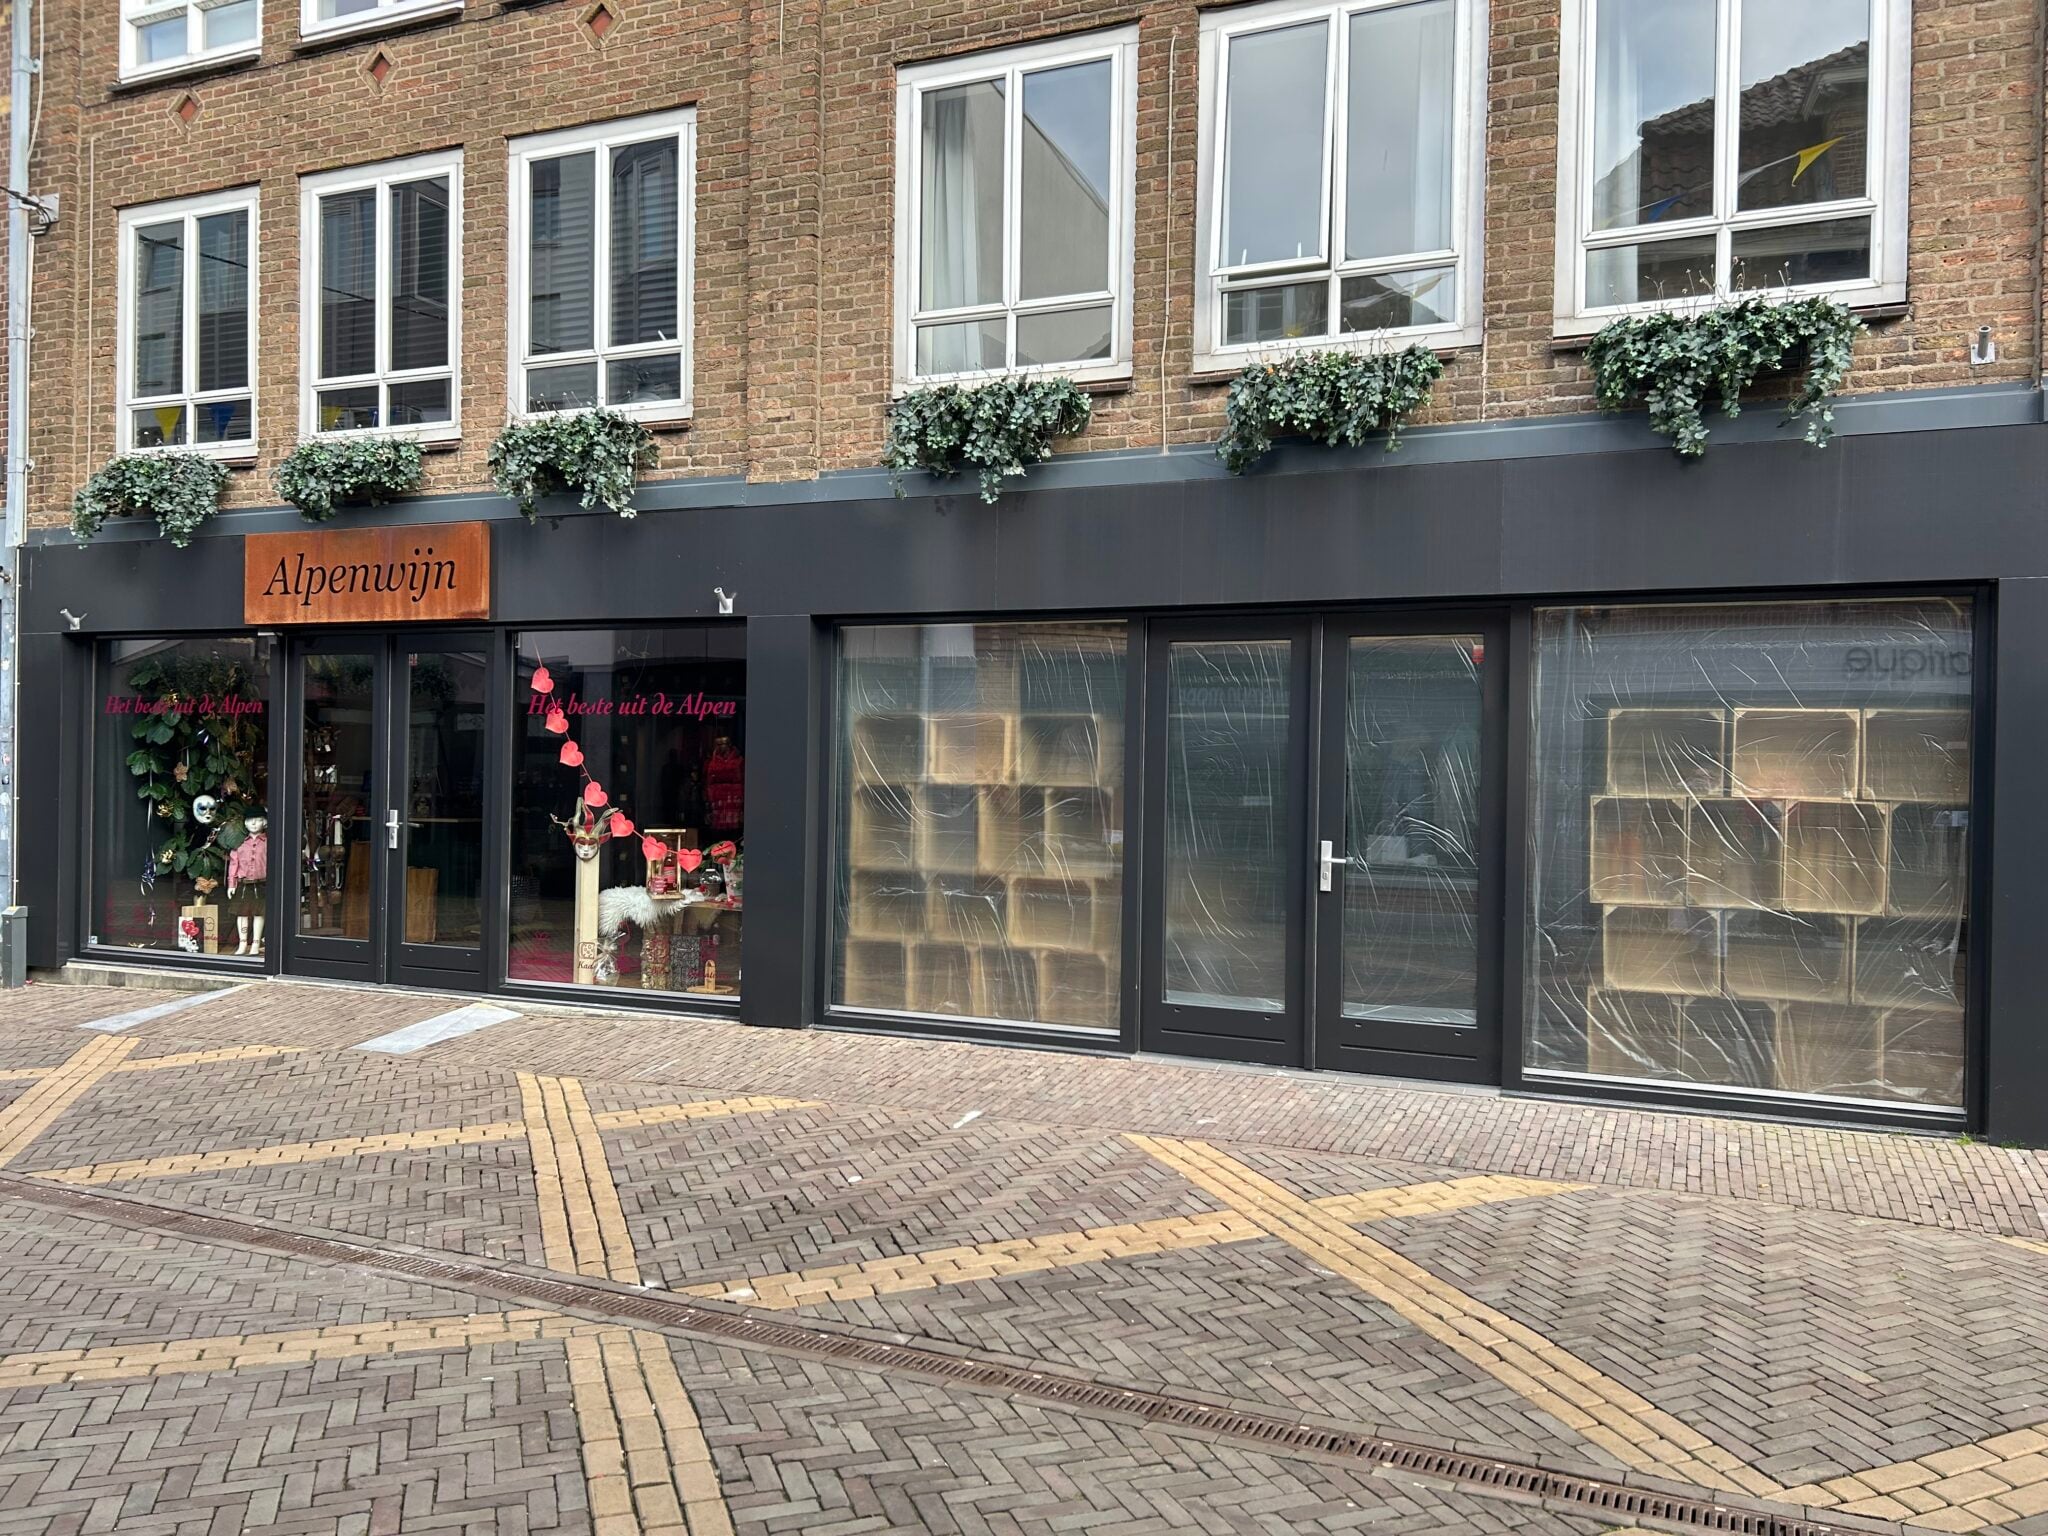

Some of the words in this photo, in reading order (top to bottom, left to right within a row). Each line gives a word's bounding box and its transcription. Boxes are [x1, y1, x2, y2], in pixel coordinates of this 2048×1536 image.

[263, 547, 457, 606] Alpenwijn
[104, 694, 131, 714] Het
[134, 693, 168, 715] beste
[173, 695, 197, 714] uit
[199, 691, 215, 713] de
[218, 693, 264, 719] Alpen
[527, 694, 564, 715] Het
[567, 693, 613, 715] beste
[618, 694, 648, 715] uit
[651, 692, 674, 715] de
[677, 692, 736, 721] Alpen
